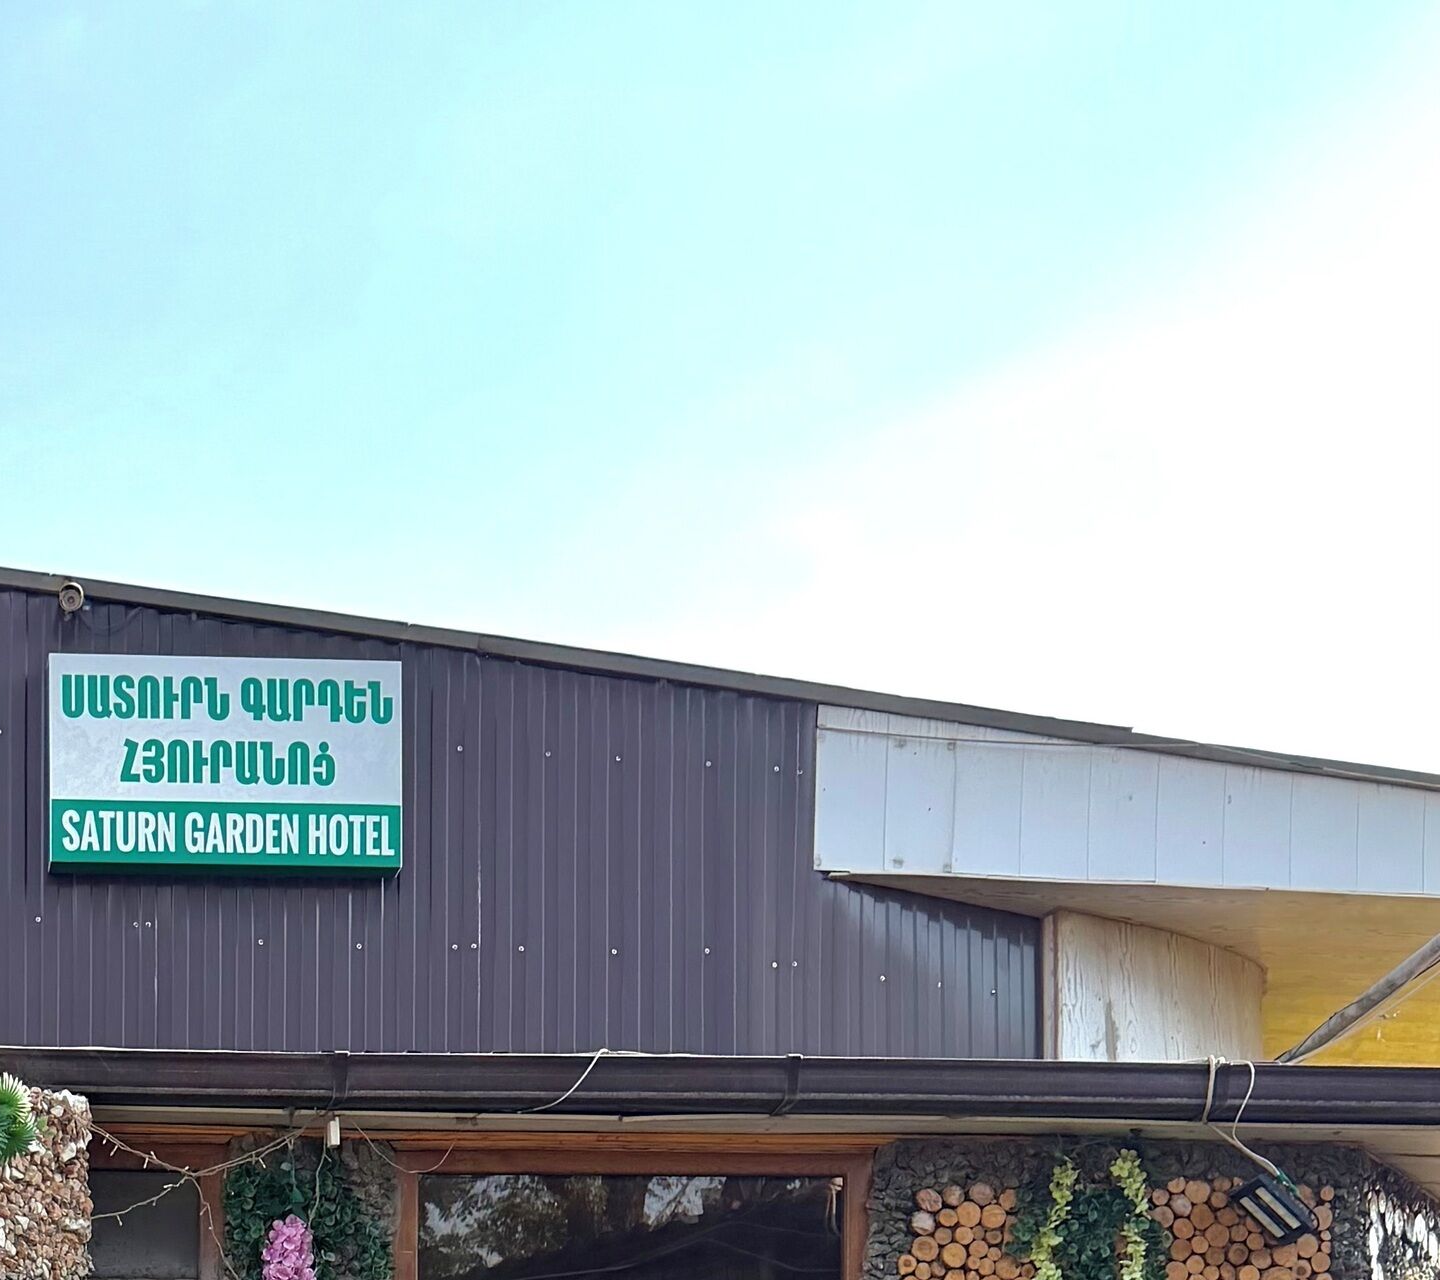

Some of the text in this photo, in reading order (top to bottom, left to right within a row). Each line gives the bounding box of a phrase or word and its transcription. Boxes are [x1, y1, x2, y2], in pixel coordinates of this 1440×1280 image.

[61, 674, 393, 724] ՍԱՏՈՒՐՆ ԳԱՐԴԵՆ
[120, 737, 336, 786] ՀՅՈՒՐԱՆՈՑ
[61, 809, 395, 856] SATURN GARDEN HOTEL
